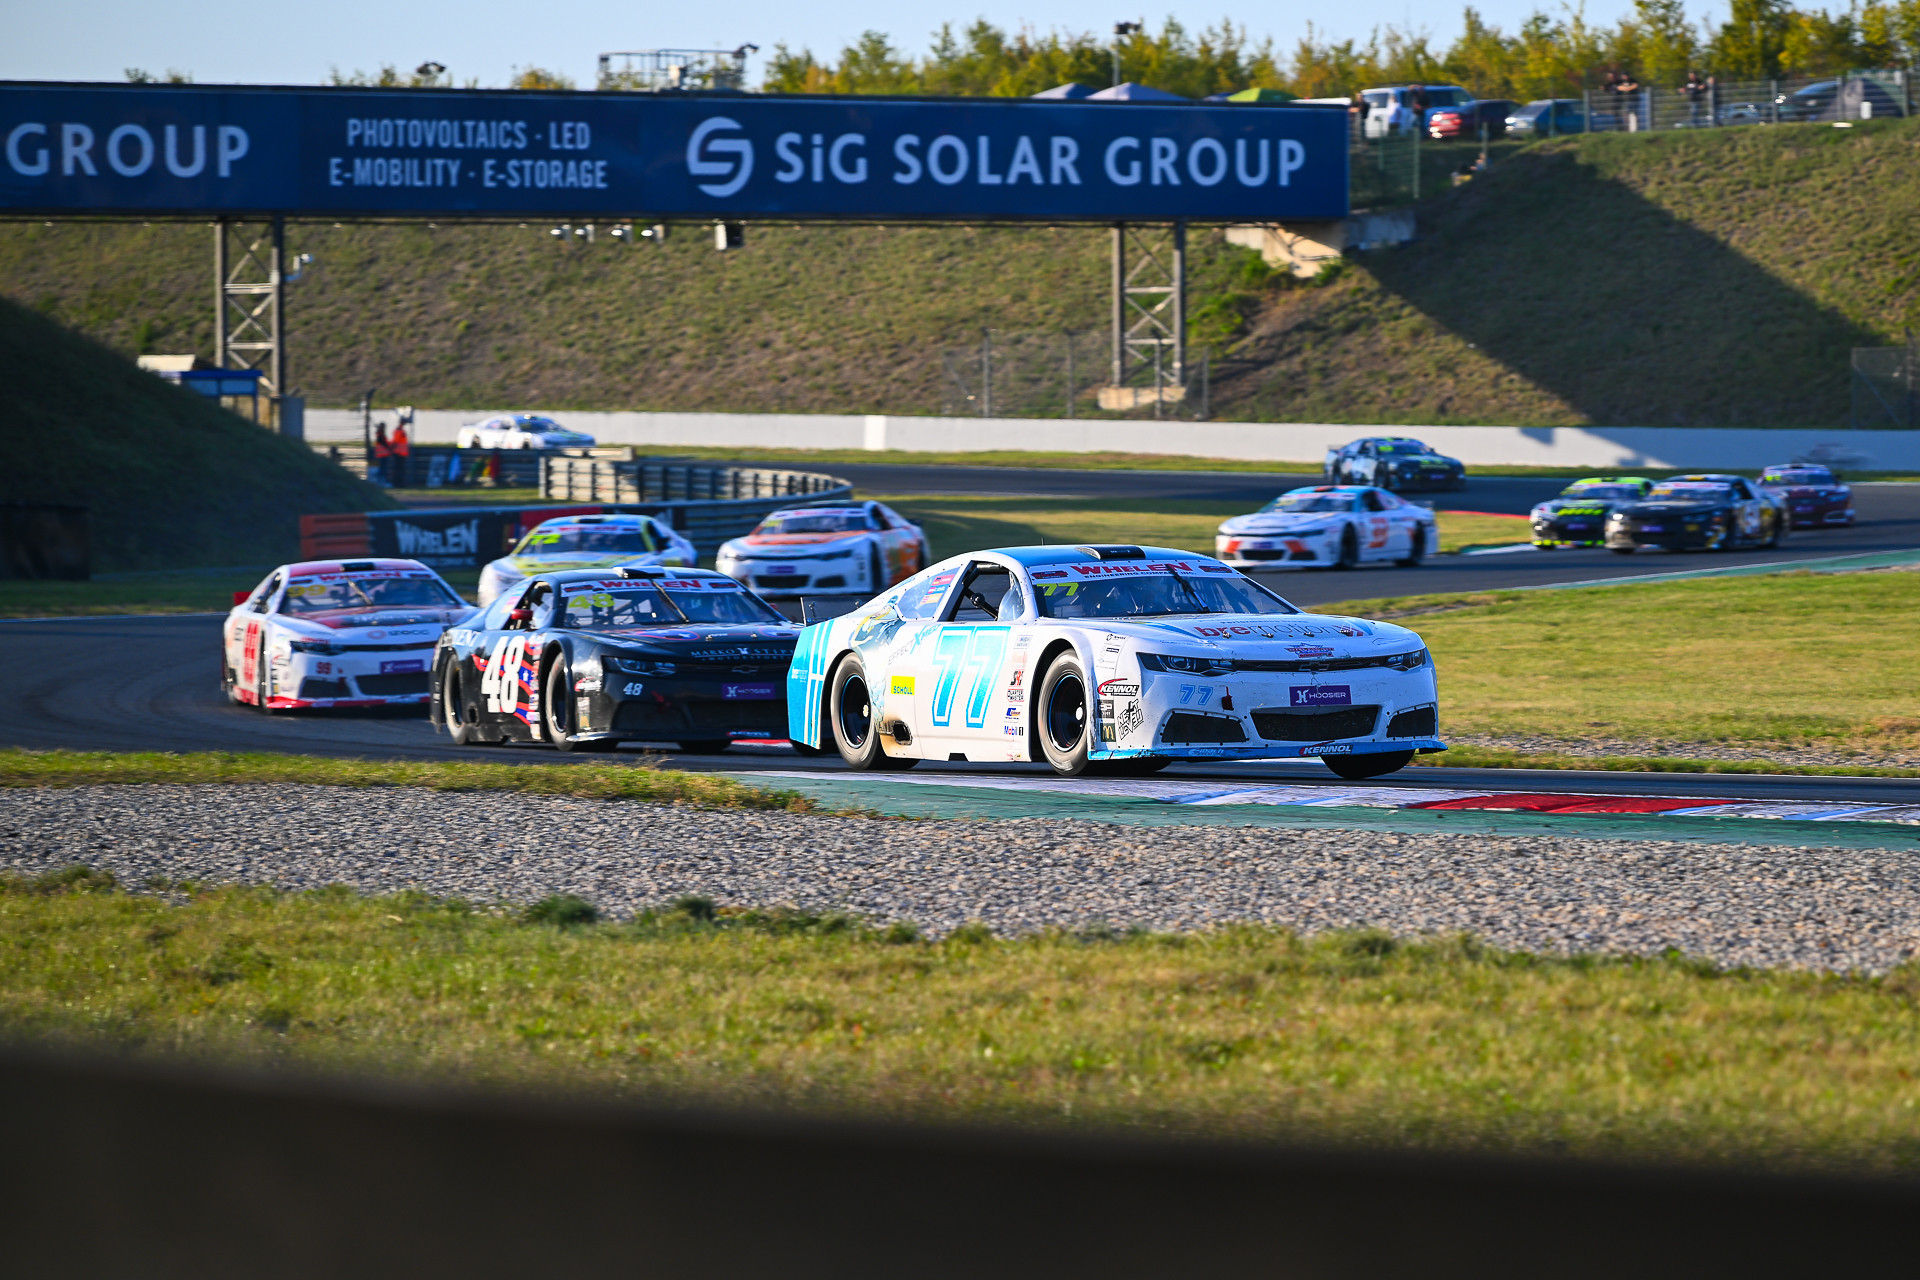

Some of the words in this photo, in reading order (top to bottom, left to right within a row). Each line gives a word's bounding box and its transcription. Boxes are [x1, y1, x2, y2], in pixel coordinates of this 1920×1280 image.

[347, 118, 527, 149] PHOTOVOLTAICS
[549, 120, 592, 151] LED
[6, 123, 250, 178] GROUP
[774, 132, 868, 183] SiG
[893, 134, 1081, 186] SOLAR
[1103, 137, 1306, 187] GROUP
[329, 158, 459, 188] E-MOBILITY
[483, 160, 609, 190] E-STORAGE
[394, 519, 479, 554] WHELEN
[1070, 562, 1193, 576] WHELEN
[286, 584, 327, 597] 99
[600, 579, 703, 590] WHELEN
[1036, 582, 1080, 597] 77
[568, 593, 615, 609] 48
[316, 661, 332, 675] 99
[481, 635, 526, 714] 48
[931, 625, 1011, 728] 77
[623, 682, 644, 696] 48
[1101, 685, 1138, 693] KENNOL
[1180, 683, 1214, 706] 77
[1309, 691, 1347, 699] HOOSIER
[1004, 726, 1018, 735] Mobil
[1303, 745, 1352, 755] KENNOL
